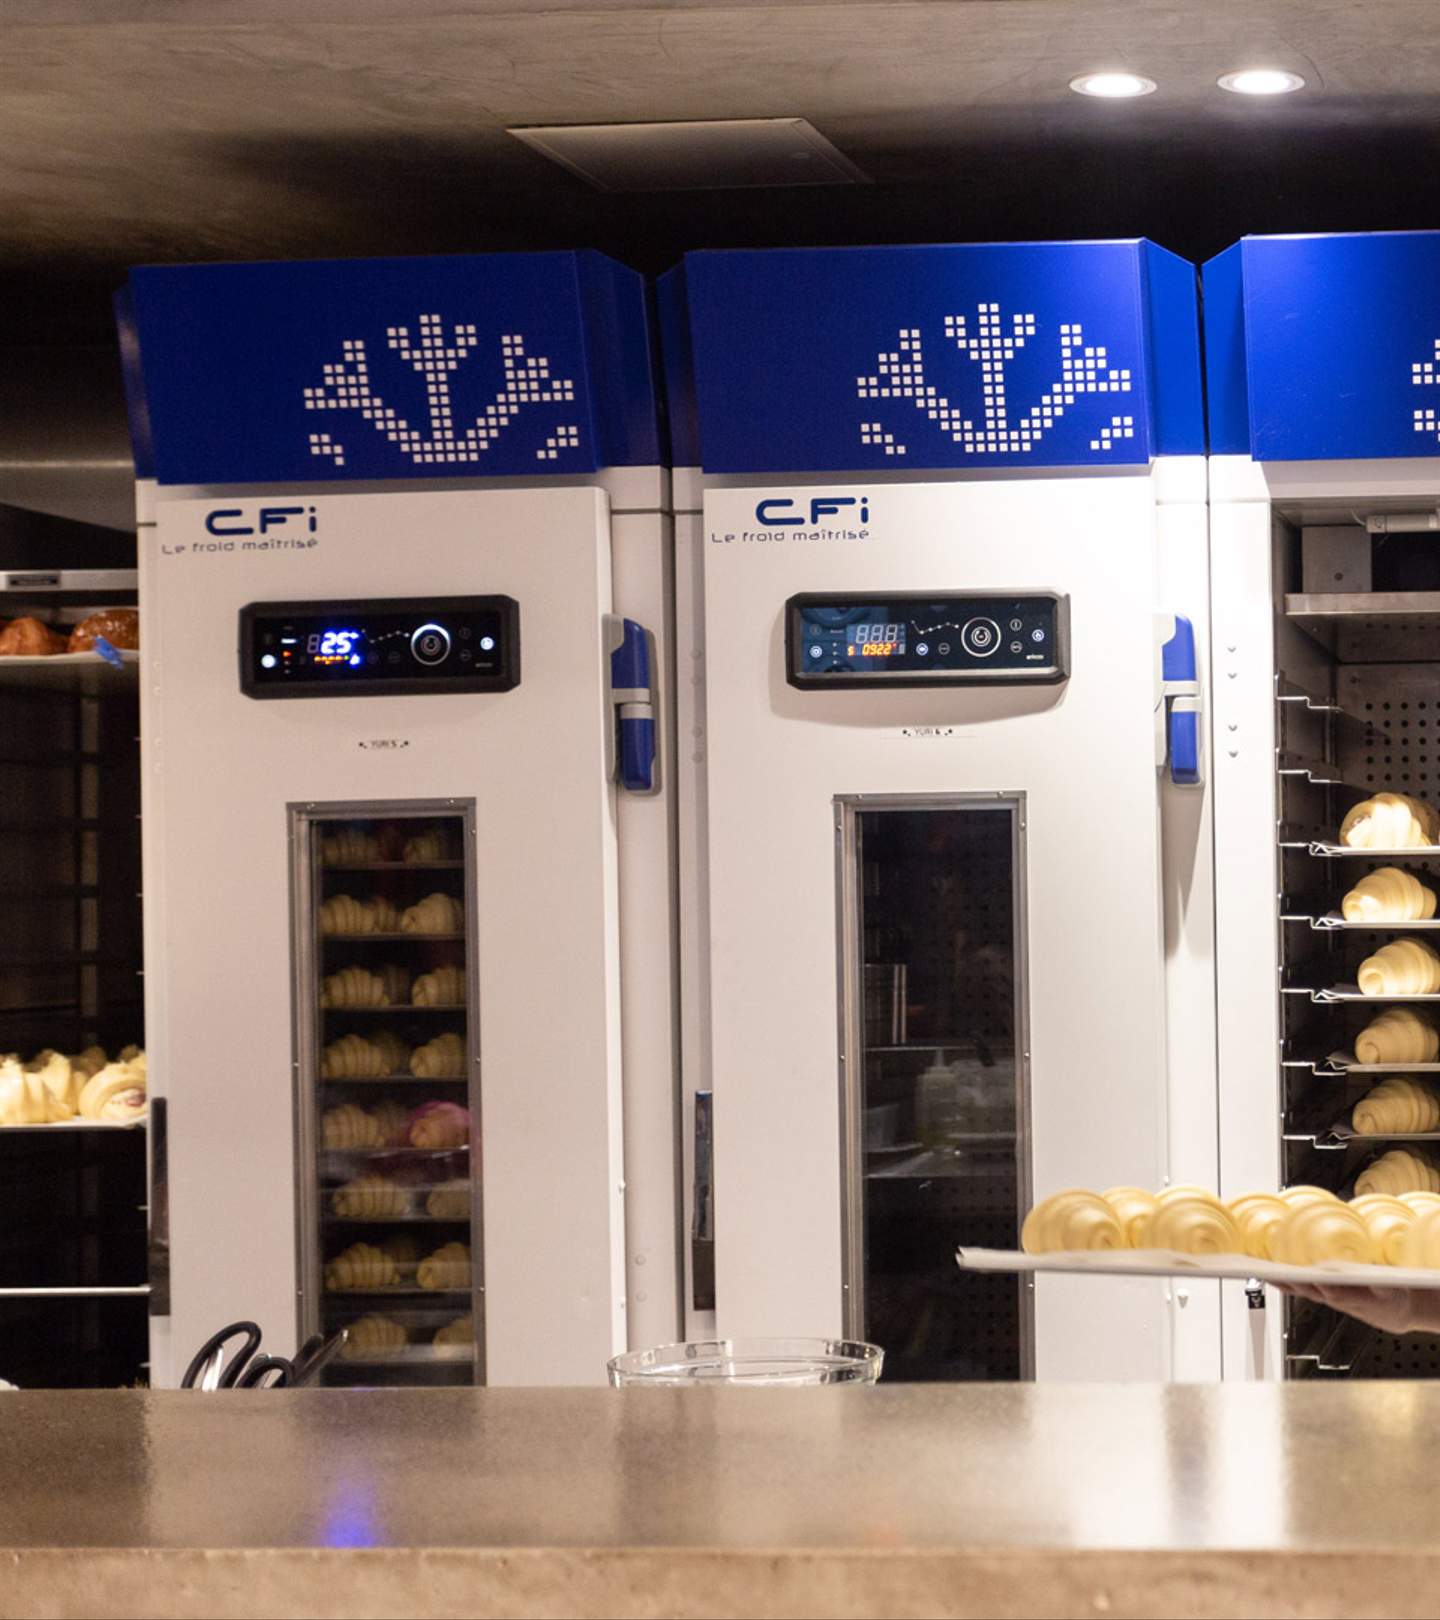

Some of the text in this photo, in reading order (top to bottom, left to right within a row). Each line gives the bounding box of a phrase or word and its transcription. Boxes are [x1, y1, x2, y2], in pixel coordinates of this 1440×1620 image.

[711, 532, 735, 543] Le
[742, 530, 786, 542] froid
[162, 544, 185, 555] Le
[192, 541, 236, 553] froid
